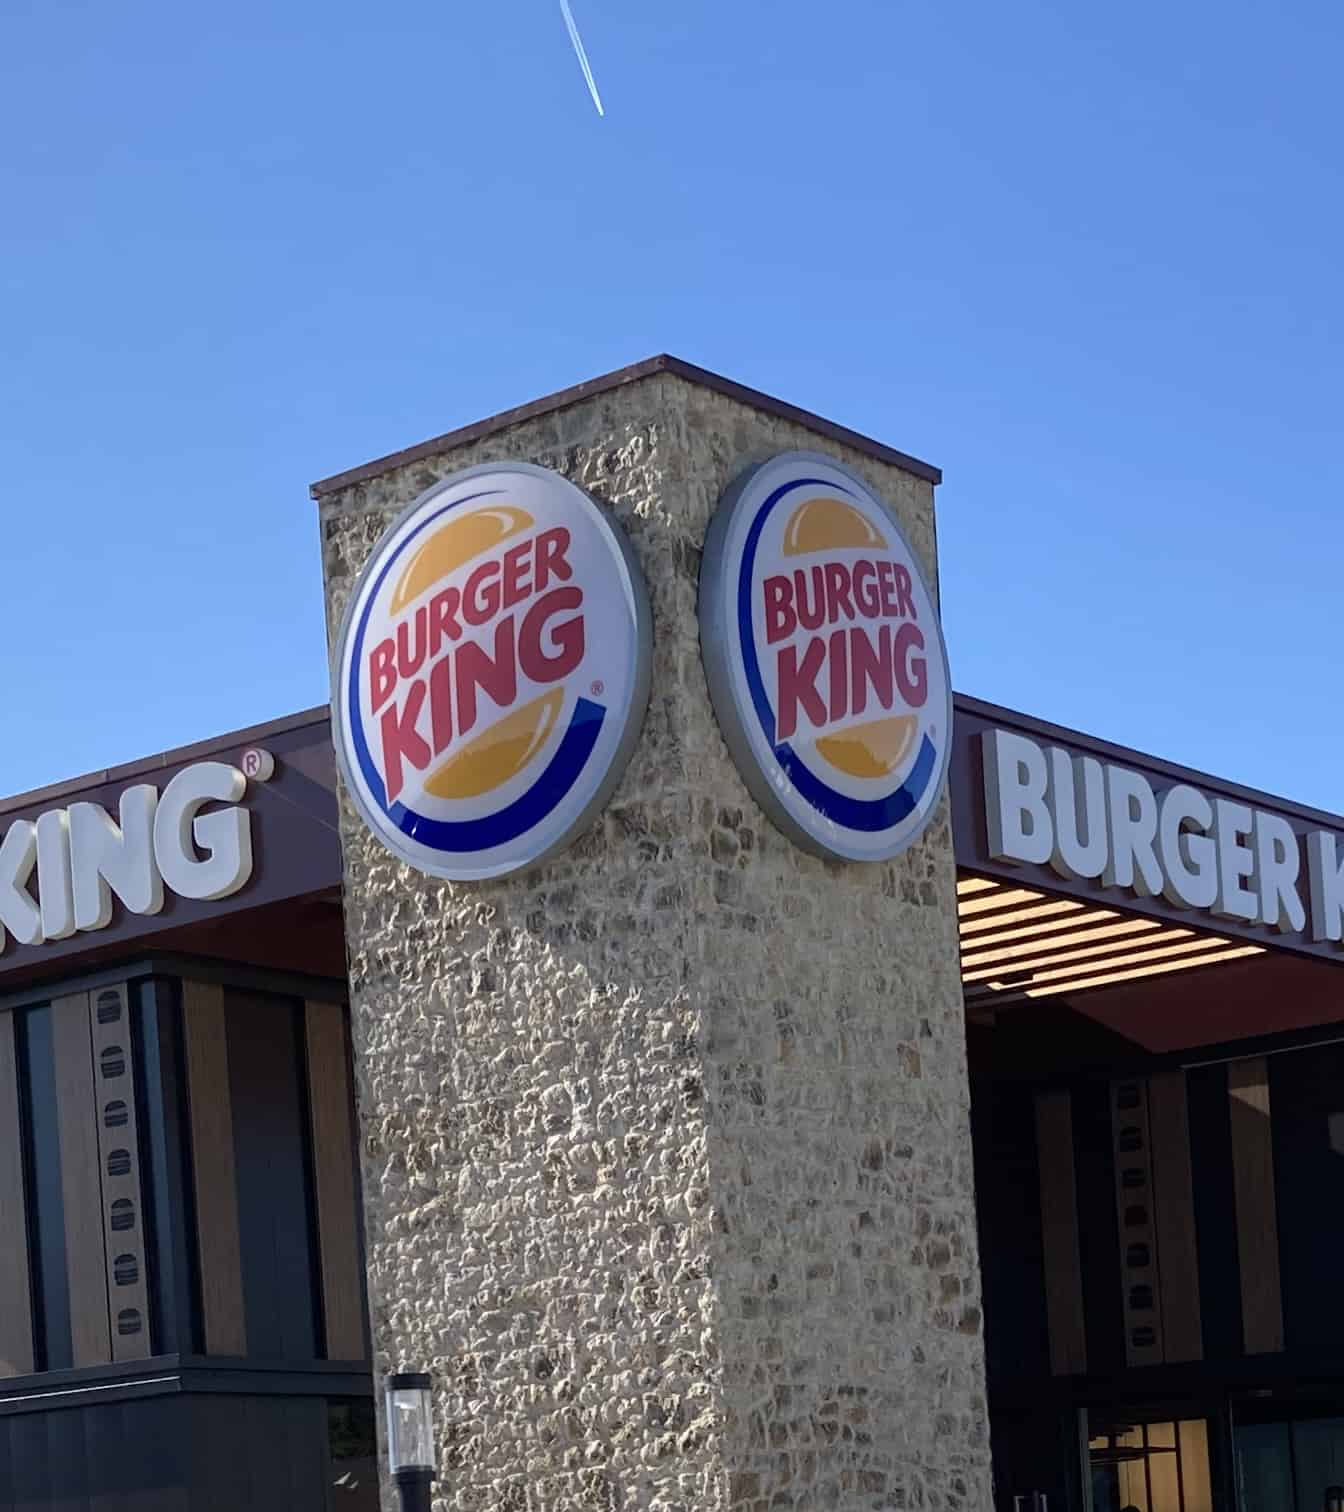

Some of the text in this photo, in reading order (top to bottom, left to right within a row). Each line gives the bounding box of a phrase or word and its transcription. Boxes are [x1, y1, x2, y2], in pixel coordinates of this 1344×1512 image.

[369, 527, 571, 713] BURGER
[380, 586, 585, 802] KING
[763, 559, 917, 645] BURGER
[775, 622, 928, 740] KING
[982, 729, 1307, 934] BURGER
